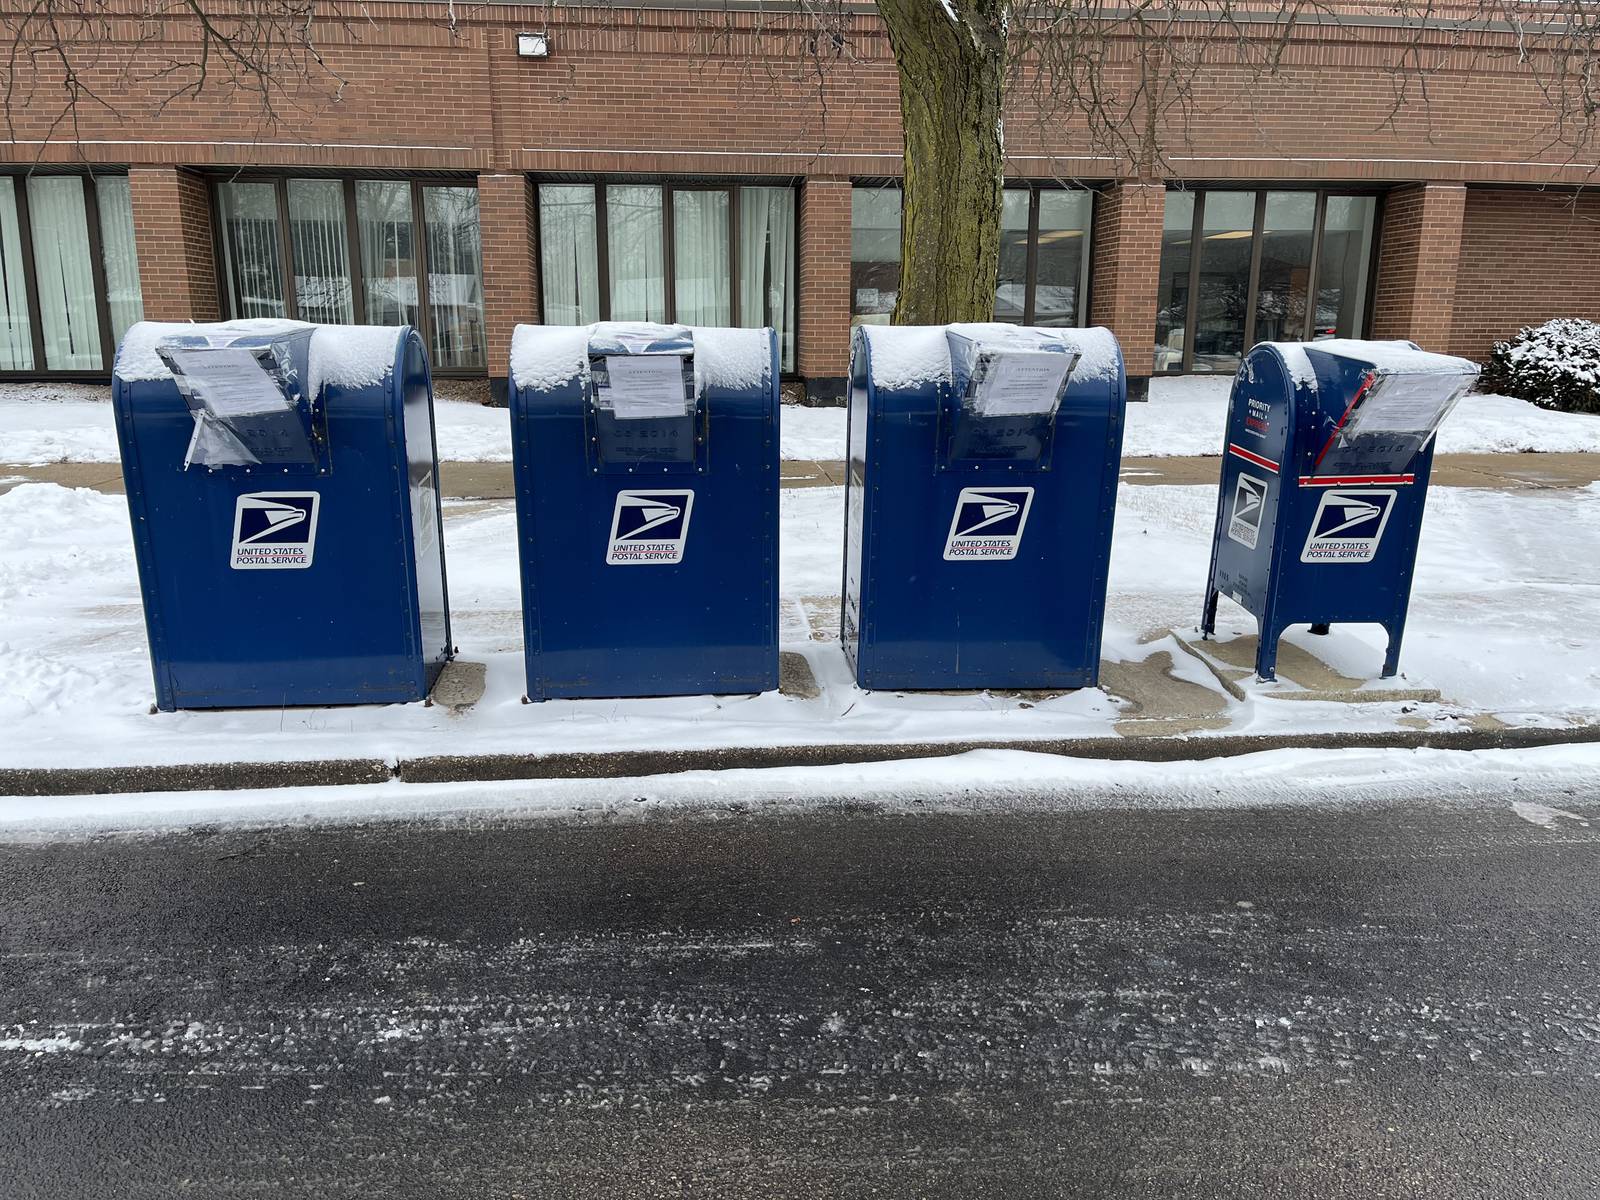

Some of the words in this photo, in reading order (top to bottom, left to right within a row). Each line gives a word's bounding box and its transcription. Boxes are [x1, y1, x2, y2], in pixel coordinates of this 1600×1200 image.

[1248, 398, 1271, 412] PRIORITY
[1252, 409, 1264, 420] MAIL
[613, 544, 646, 552] UNITED
[951, 540, 982, 548] UNITED
[1339, 542, 1370, 550] STATES
[237, 547, 271, 556] UNITED
[272, 547, 304, 555] STATES
[980, 548, 1013, 556] SERVICE
[644, 552, 678, 560] SERVICE
[236, 556, 270, 565] POSTAL
[271, 556, 307, 564] SERVICE
